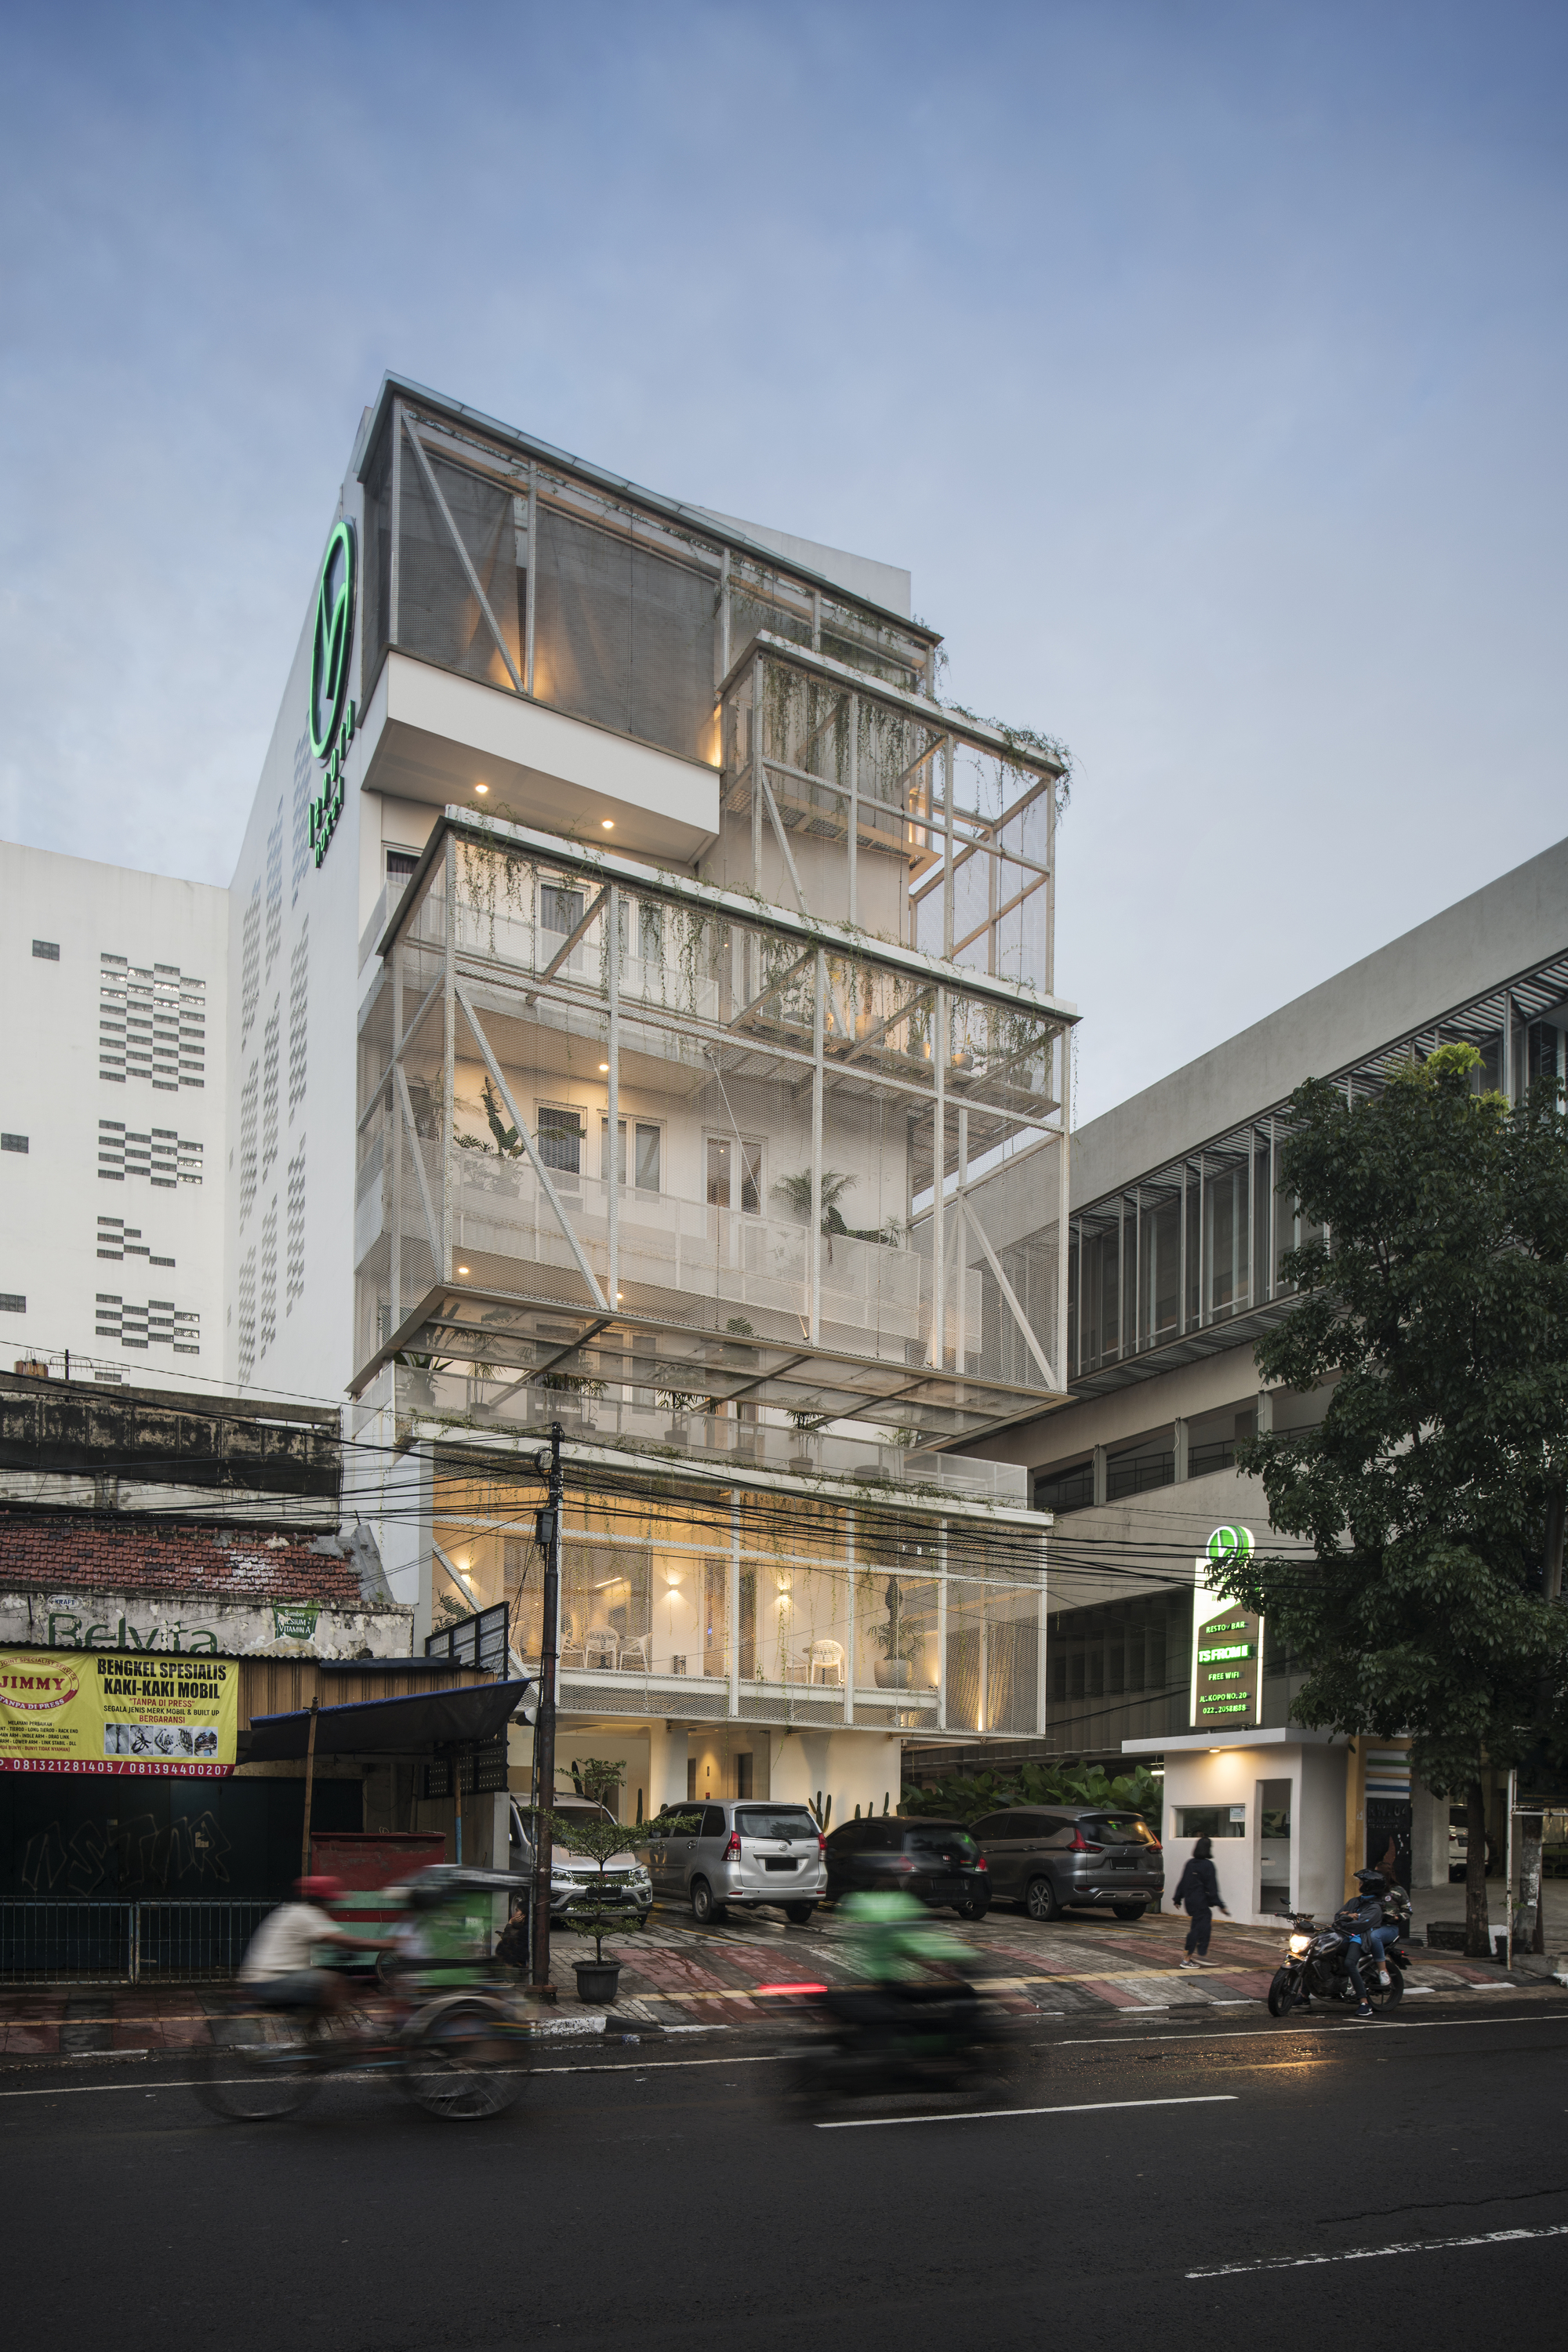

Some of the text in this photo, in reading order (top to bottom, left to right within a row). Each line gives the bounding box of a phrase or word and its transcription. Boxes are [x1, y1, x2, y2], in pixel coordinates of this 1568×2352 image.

[315, 775, 345, 869] hotel
[278, 1624, 305, 1633] VITAMIN
[1206, 1624, 1226, 1634] RESTO
[1231, 1621, 1246, 1630] BAR
[1, 1657, 78, 1681] JOINT SPECIALIST SERVICE
[97, 1658, 227, 1681] BENGKEL SPESIALIS
[1208, 1671, 1240, 1681] FREE WIFI
[0, 1675, 65, 1690] JIMMY
[103, 1678, 220, 1699] KAKI-KAKI MOBIL
[0, 1696, 26, 1709] TANPA
[39, 1698, 64, 1709] PRESS
[139, 1715, 186, 1724] BERGARANSI
[13, 1759, 113, 1772] 081321281405
[129, 1762, 228, 1776] 081394400207
